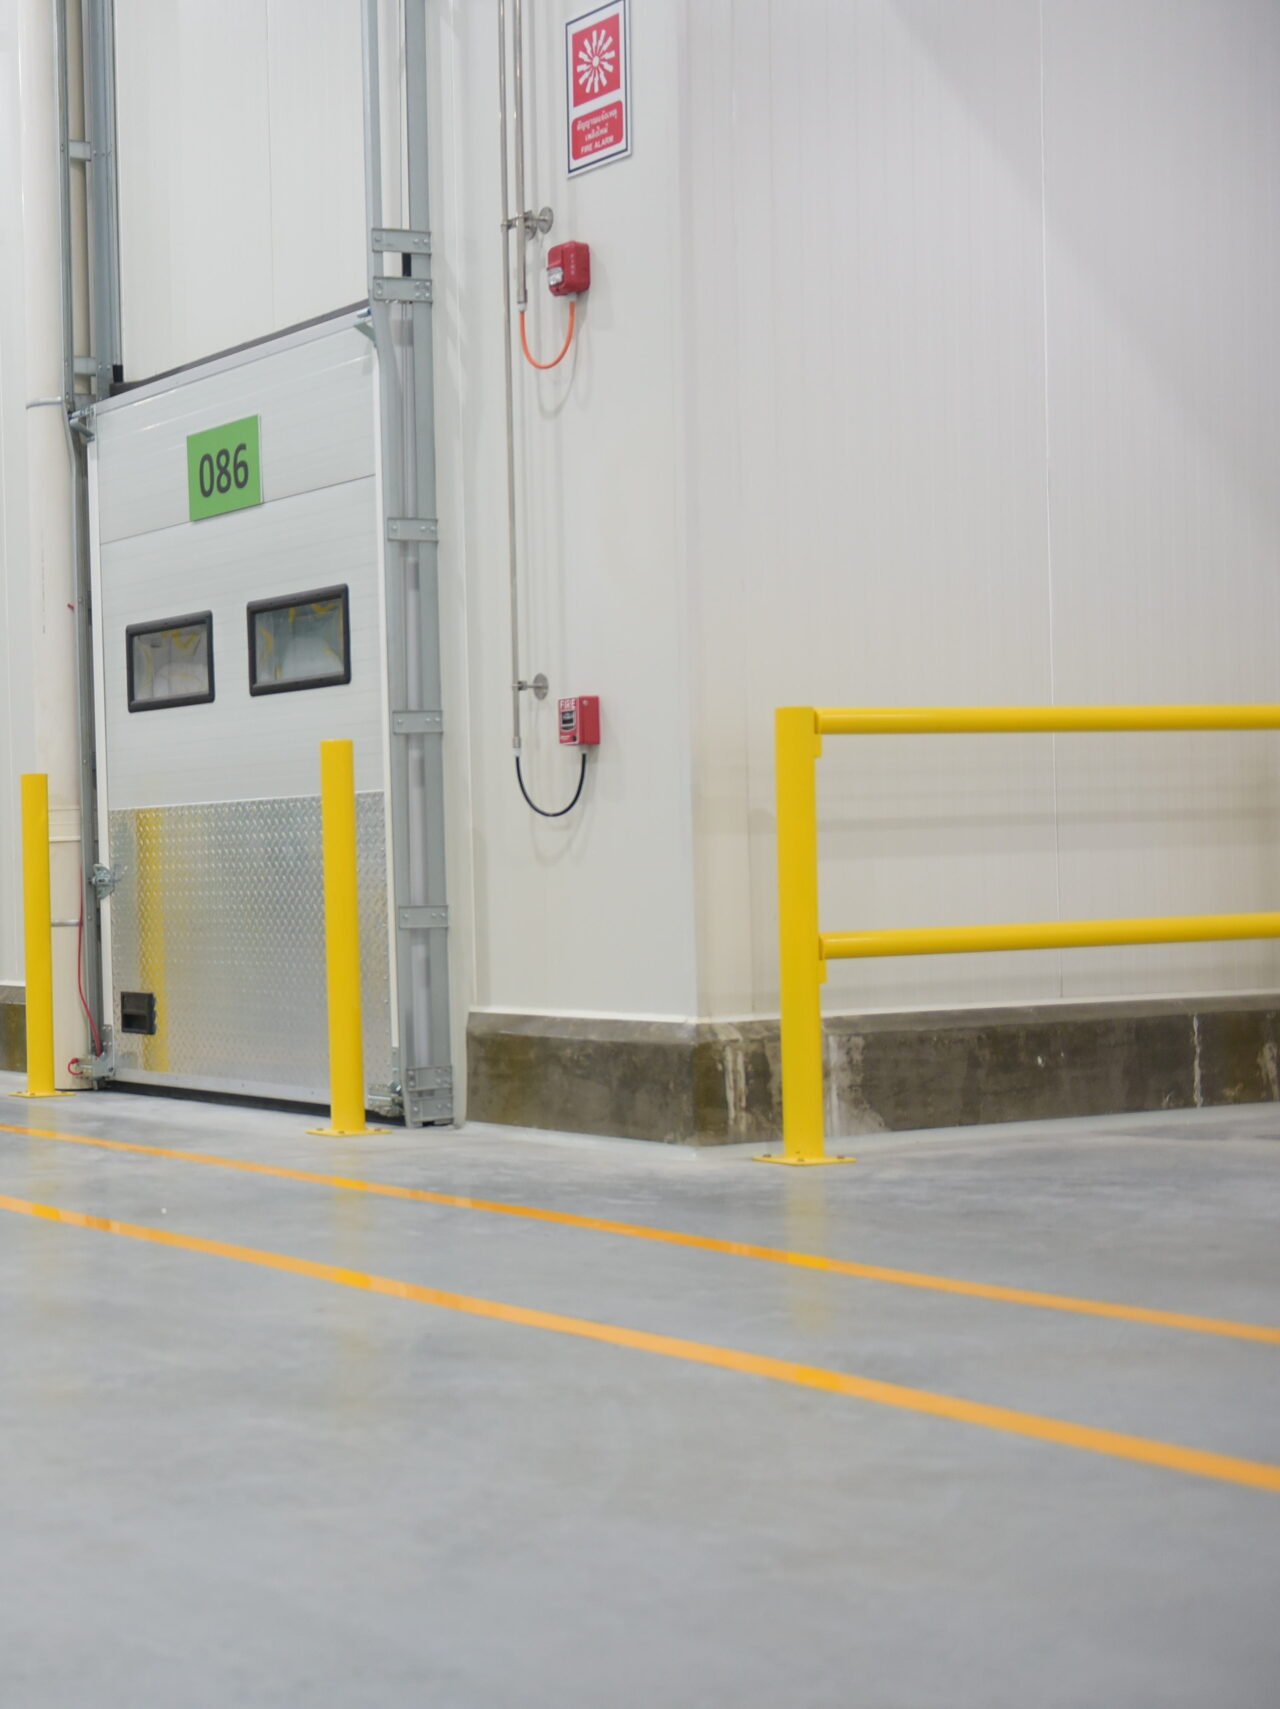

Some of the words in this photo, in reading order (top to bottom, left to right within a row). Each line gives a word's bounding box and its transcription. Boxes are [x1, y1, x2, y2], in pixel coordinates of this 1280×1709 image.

[580, 143, 593, 155] FIRE
[594, 135, 614, 149] ALARM
[199, 443, 249, 498] 086
[560, 698, 577, 711] FIRE
